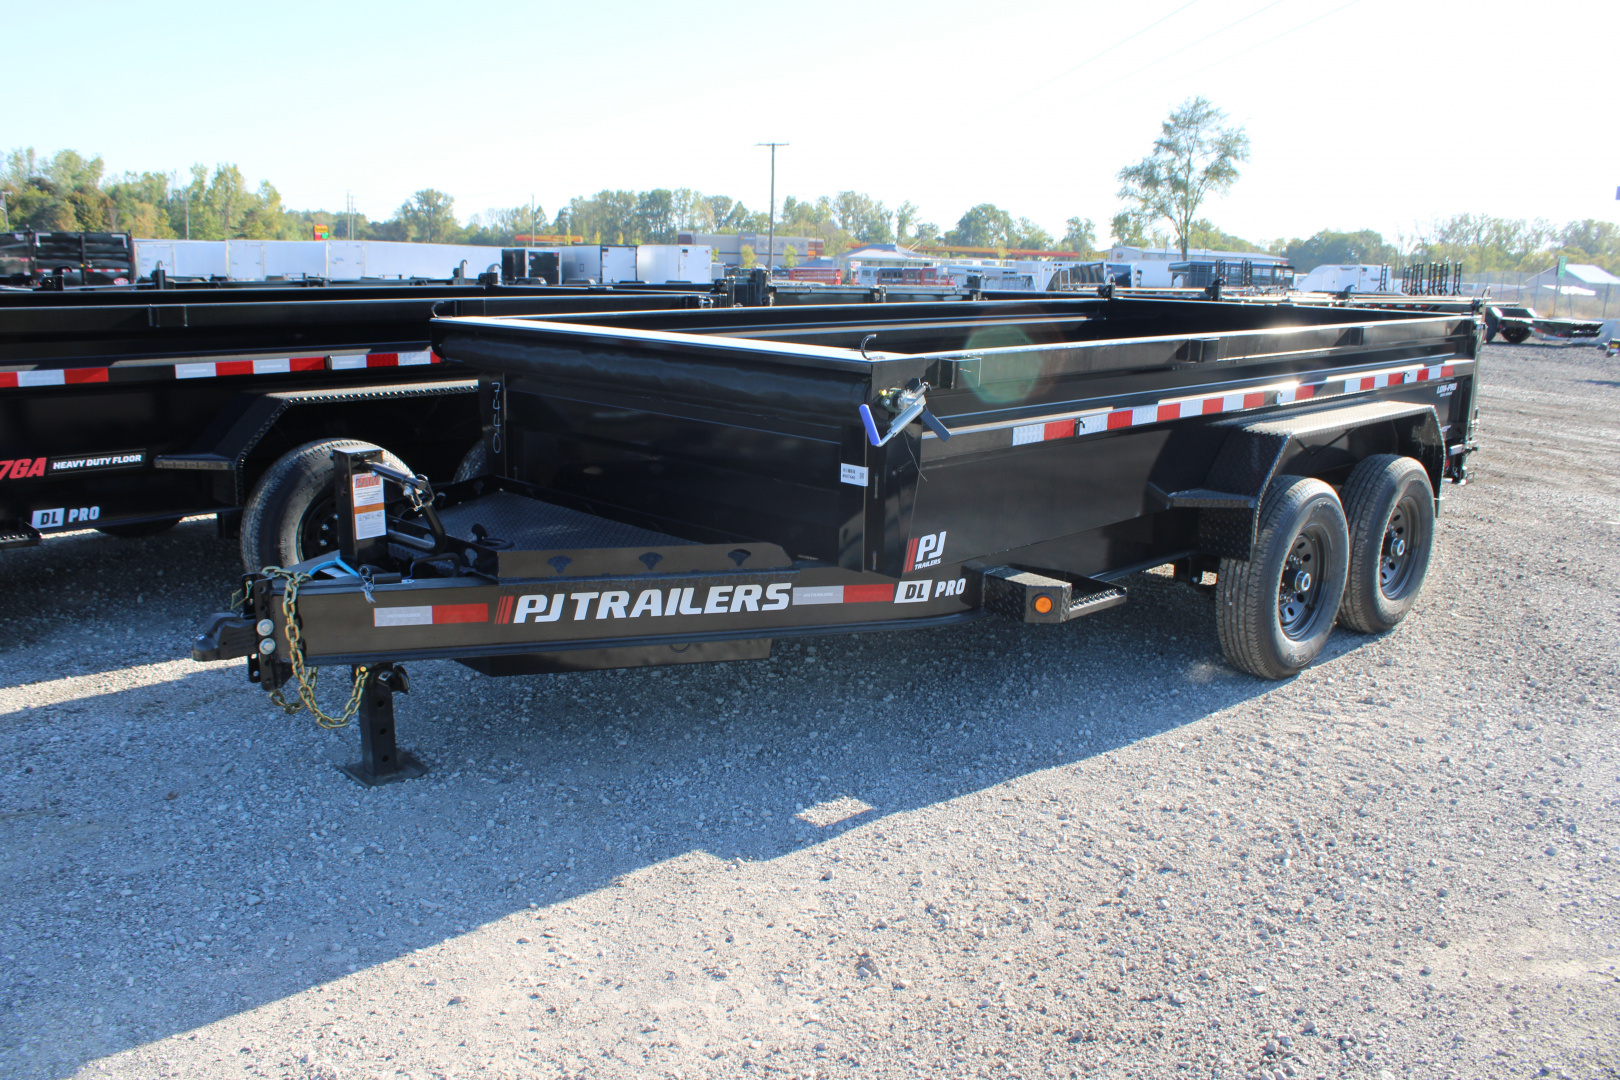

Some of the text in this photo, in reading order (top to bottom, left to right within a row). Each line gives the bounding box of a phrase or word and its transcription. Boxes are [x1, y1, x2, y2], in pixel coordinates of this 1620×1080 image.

[0, 454, 142, 480] 7GA HEAVY DUTY FLOOR
[40, 506, 100, 525] DL PRO
[916, 531, 947, 562] PJ
[915, 558, 941, 570] TRAILERS
[905, 578, 967, 599] DL PRO
[513, 582, 792, 623] PJ TRAILERS
